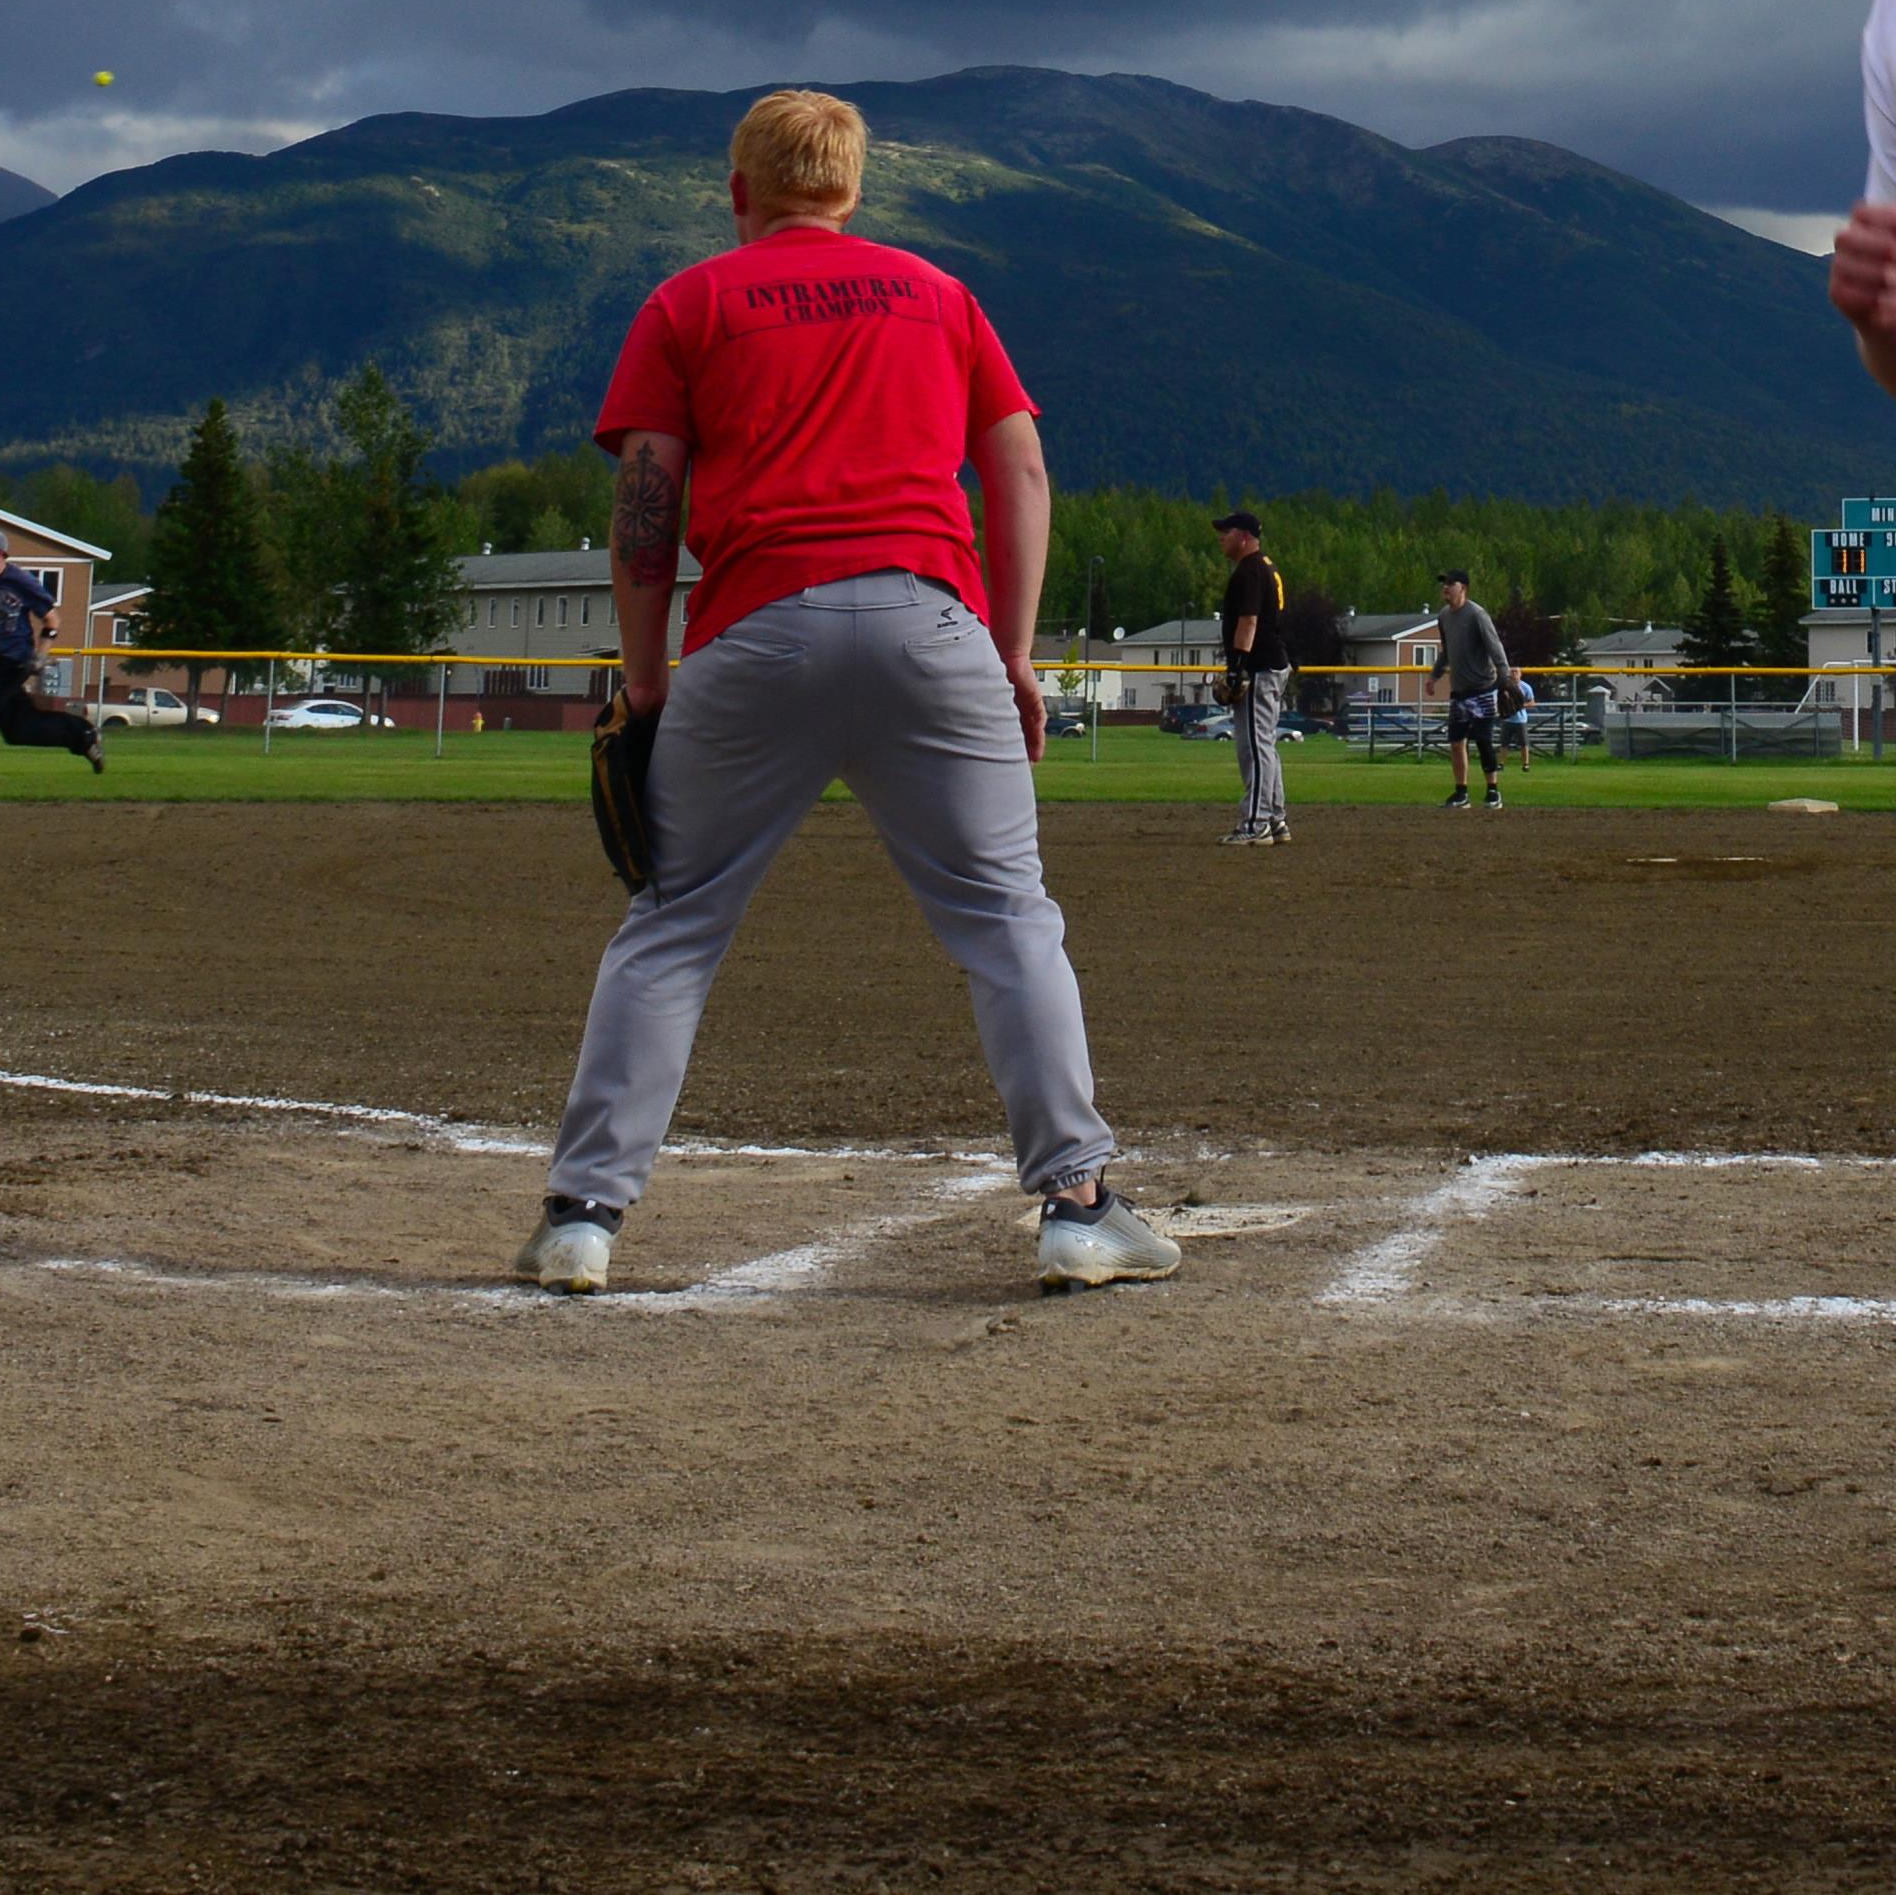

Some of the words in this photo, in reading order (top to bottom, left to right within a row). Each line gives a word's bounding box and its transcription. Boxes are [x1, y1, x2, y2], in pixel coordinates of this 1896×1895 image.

[746, 278, 921, 309] INTRAMURAL
[783, 297, 891, 323] CHAMPION
[1871, 507, 1895, 522] MIN
[1832, 532, 1865, 547] HOME
[1841, 549, 1865, 574] 11
[1829, 579, 1858, 594] BALL
